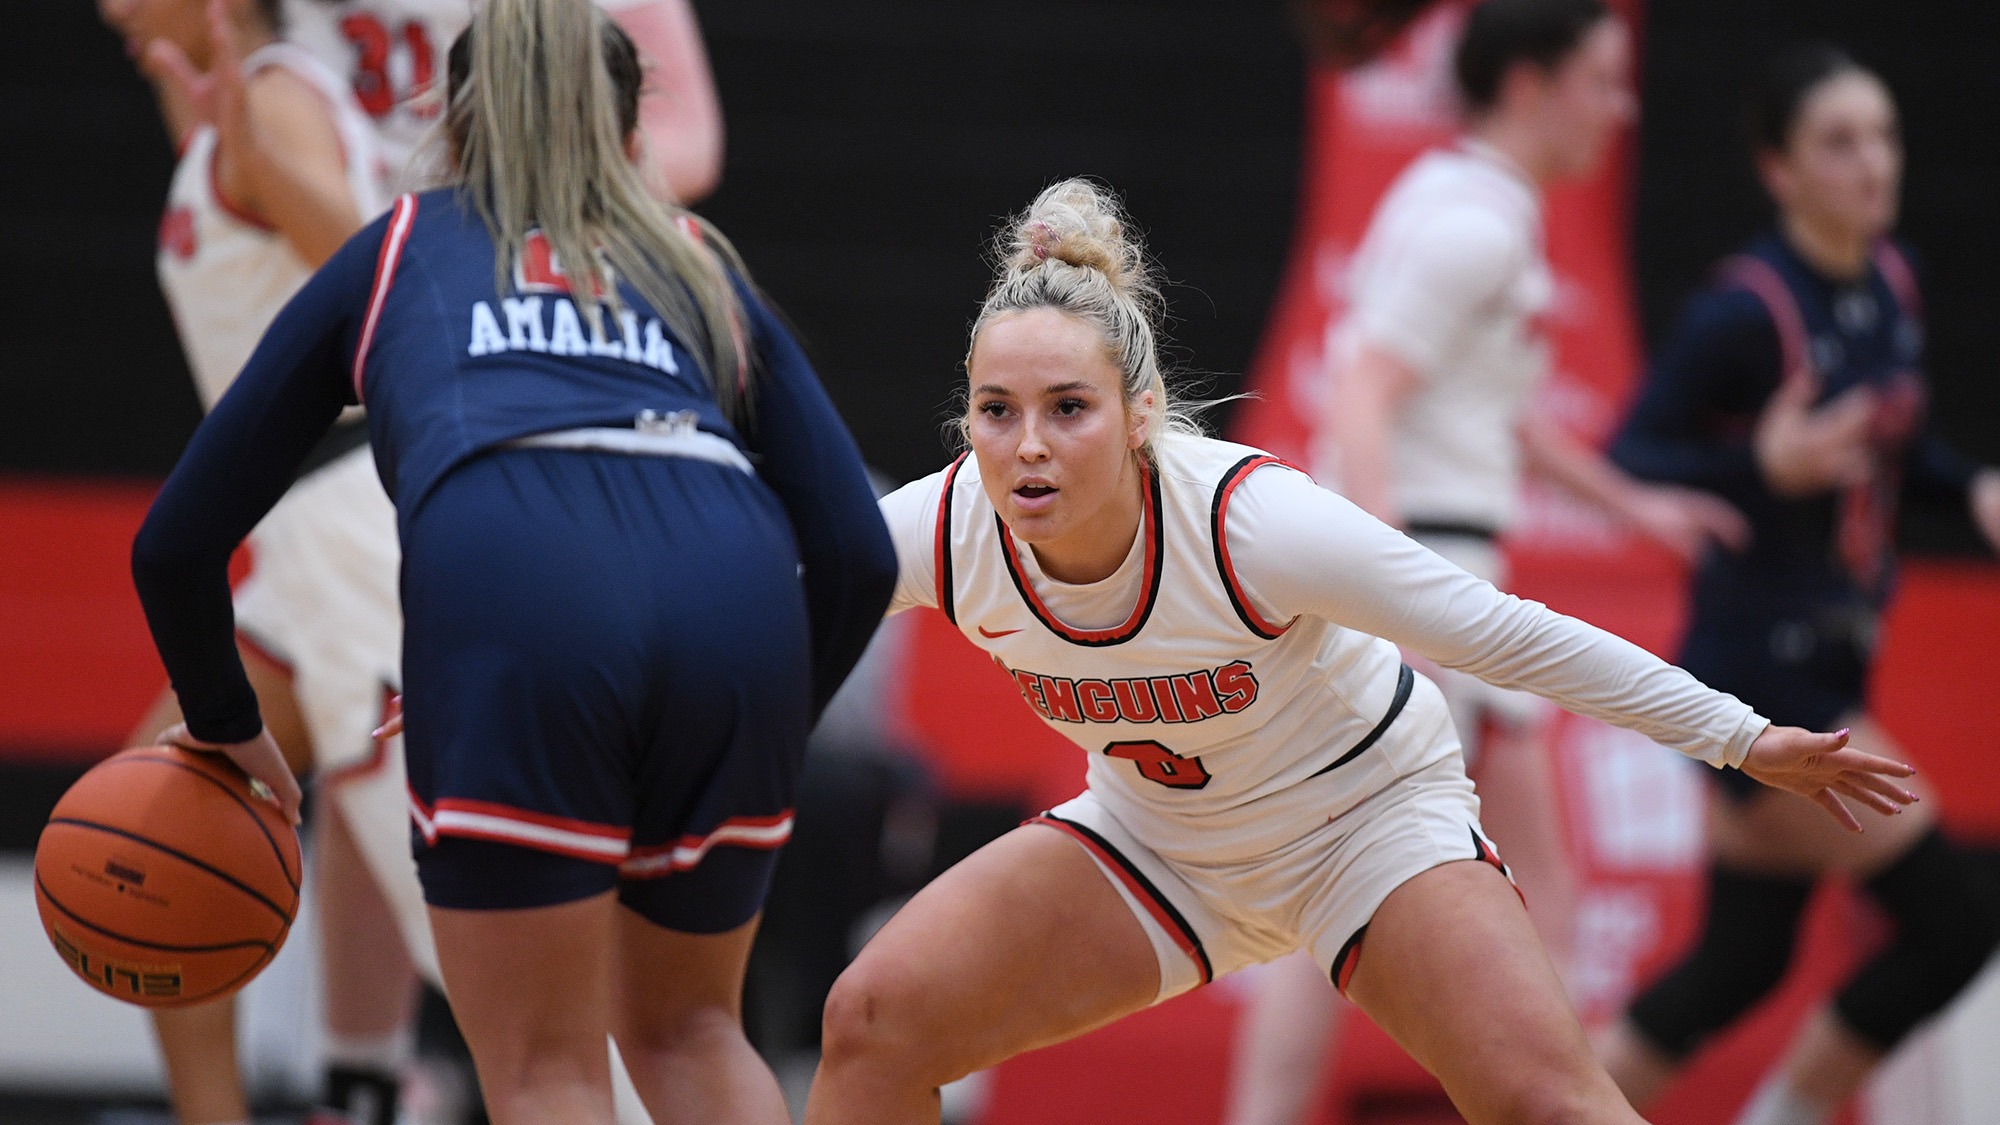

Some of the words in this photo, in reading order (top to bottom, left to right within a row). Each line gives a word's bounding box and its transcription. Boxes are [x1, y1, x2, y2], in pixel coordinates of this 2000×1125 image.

[339, 10, 442, 120] 31
[468, 296, 680, 376] AMALIA
[993, 655, 1260, 724] ENGUINS
